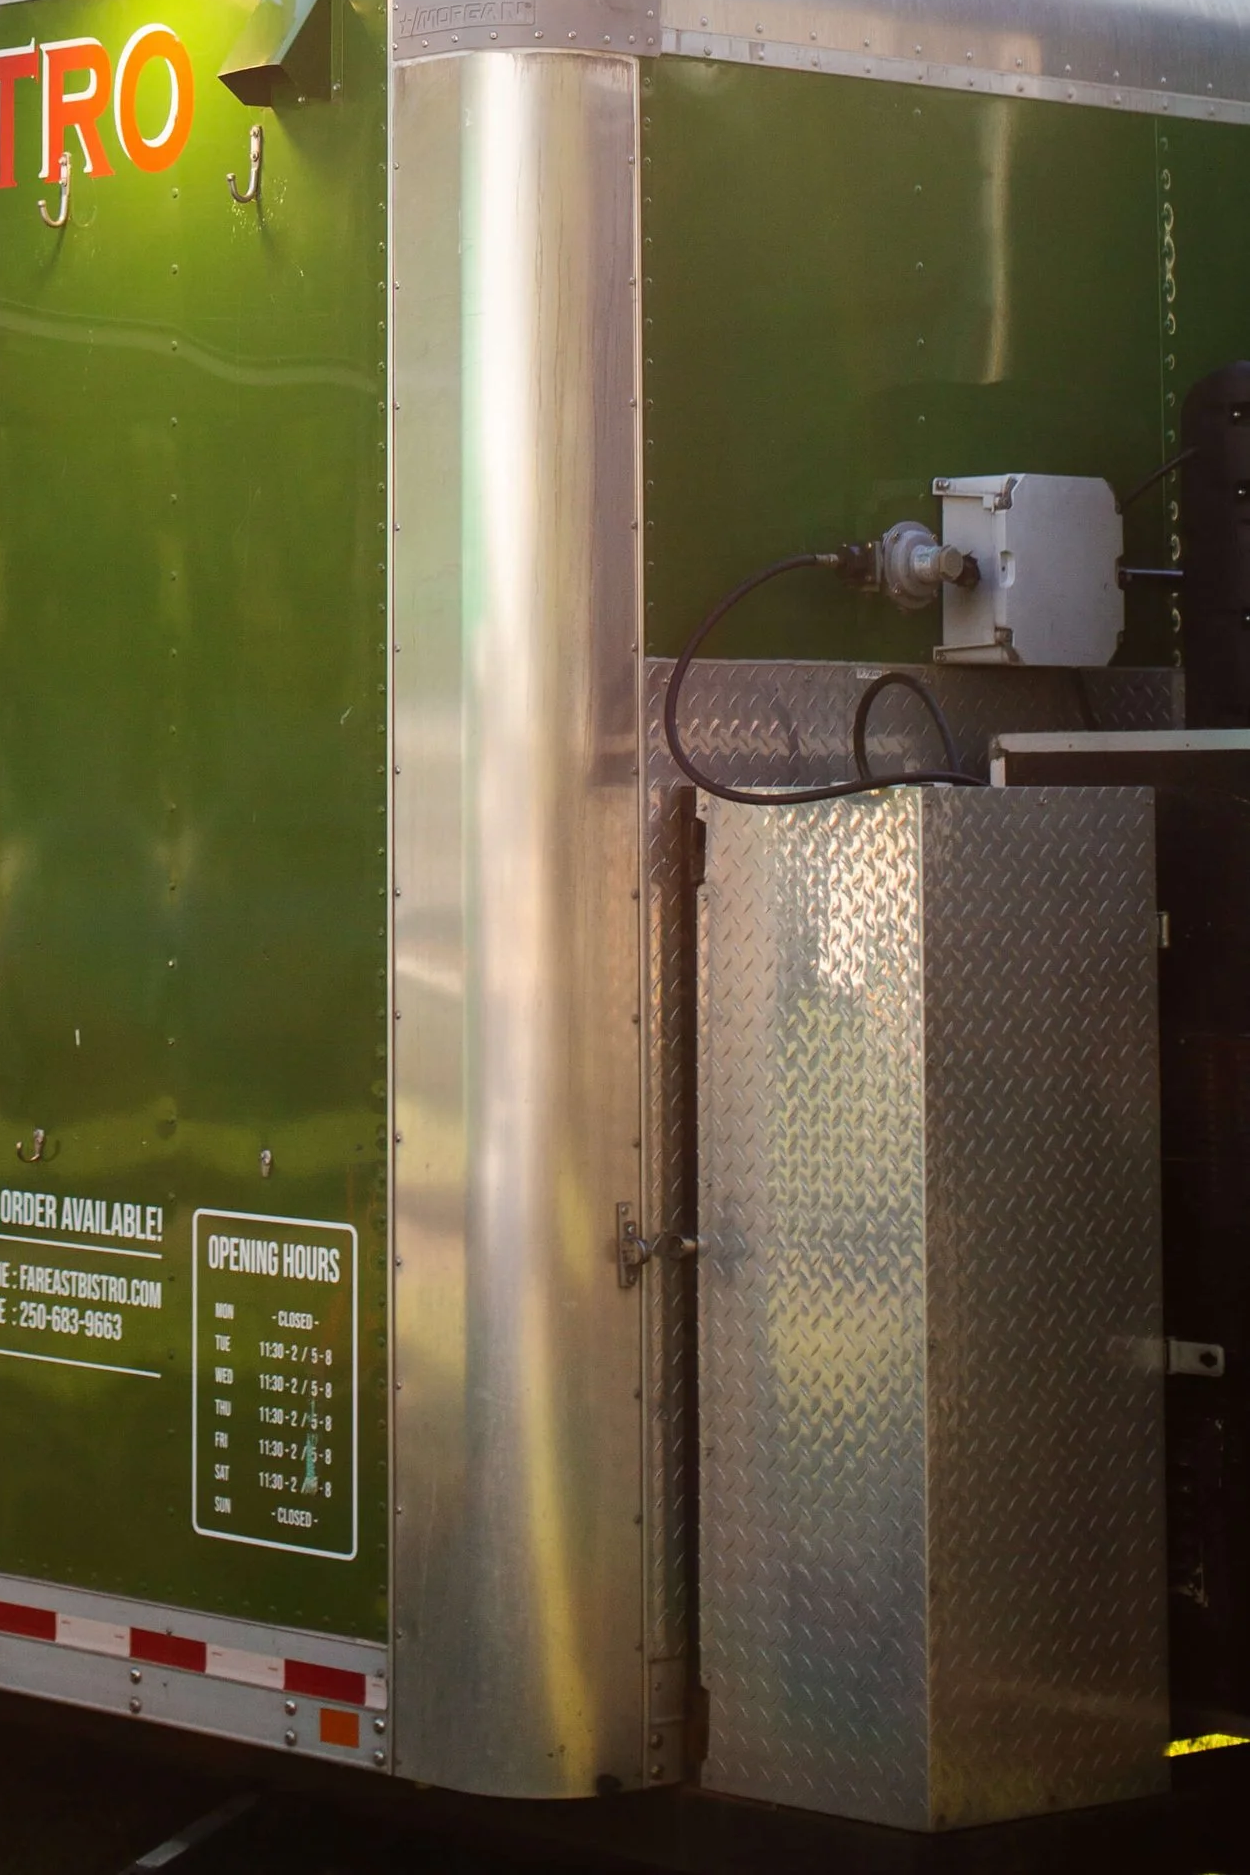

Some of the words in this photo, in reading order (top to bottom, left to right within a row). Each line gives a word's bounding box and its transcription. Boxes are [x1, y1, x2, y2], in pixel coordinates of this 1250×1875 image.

[0, 1189, 57, 1229] ORDER
[61, 1197, 163, 1242] AVAILABLE!
[208, 1234, 279, 1276] OPENING
[283, 1243, 340, 1283] HOURS
[19, 1264, 162, 1309] FAREASTBISTRO.COM
[214, 1302, 235, 1320] MON
[19, 1301, 123, 1341] 250-683-9663
[214, 1334, 231, 1352] TUE
[214, 1367, 234, 1385] WED
[214, 1399, 232, 1417] THU
[214, 1431, 229, 1449] FRI
[214, 1464, 230, 1481] SAT
[214, 1496, 232, 1514] SUN
